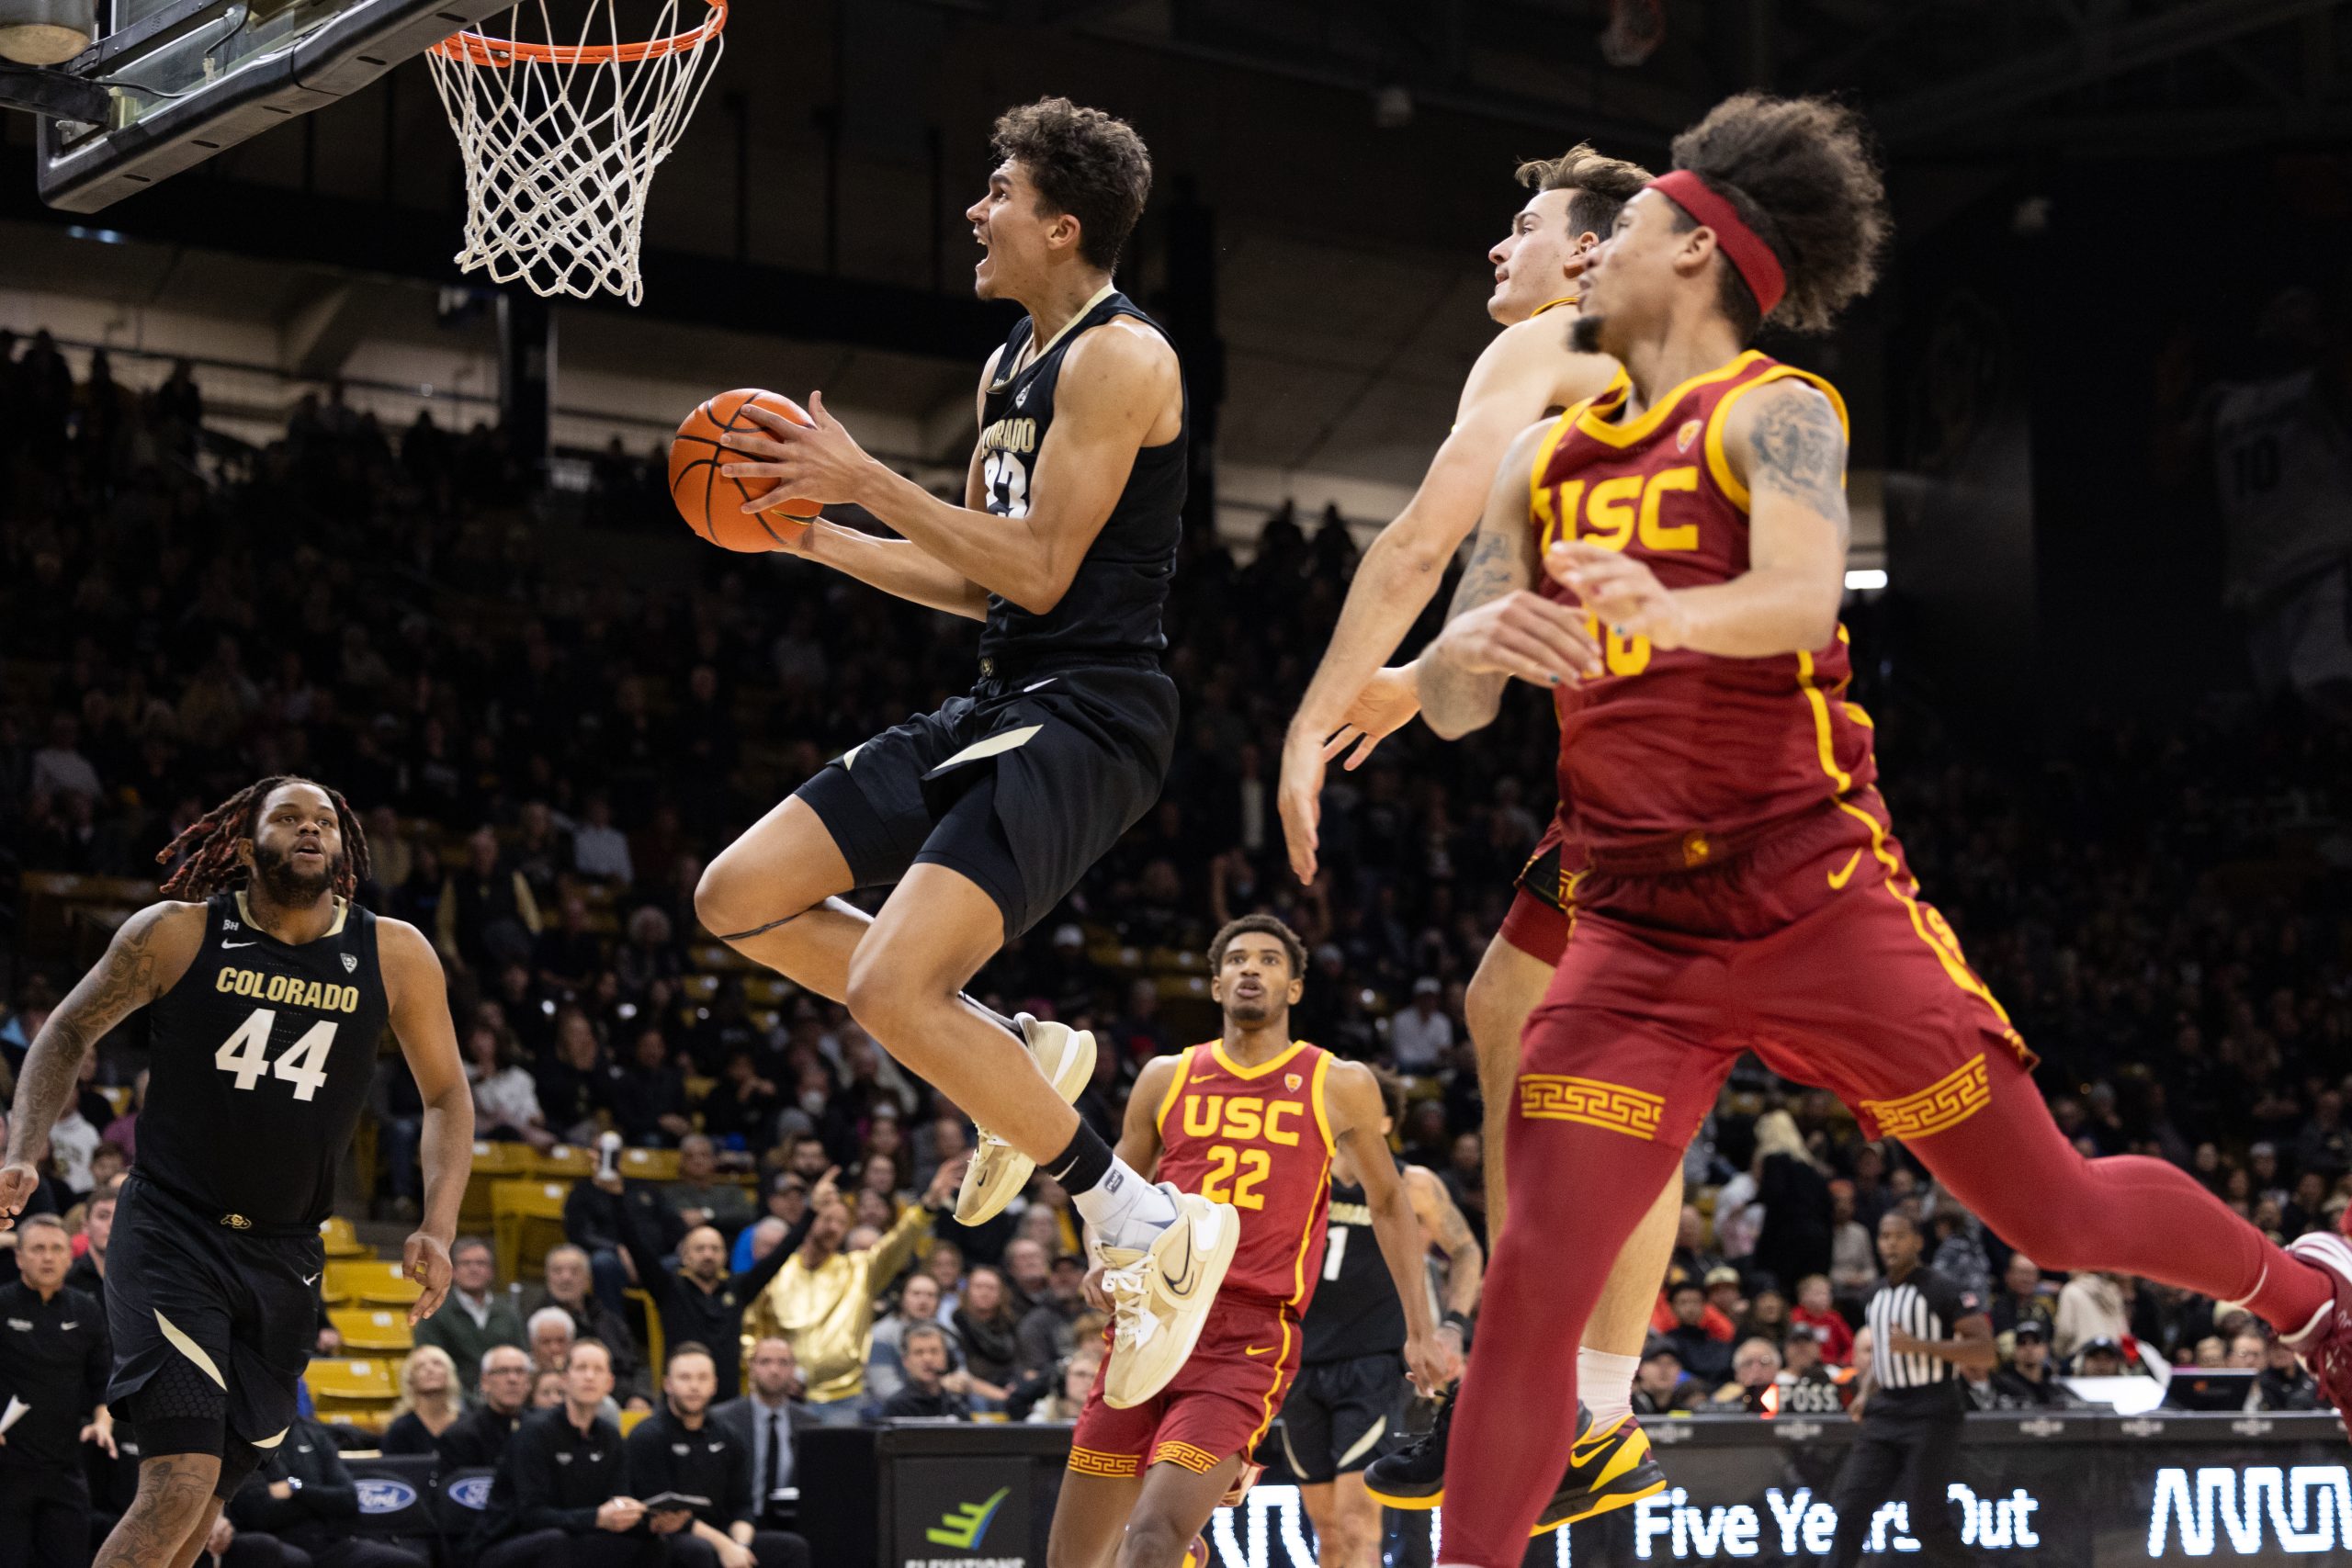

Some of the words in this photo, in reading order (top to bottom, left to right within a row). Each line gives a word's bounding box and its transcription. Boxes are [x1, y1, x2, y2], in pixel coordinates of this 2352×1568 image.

[215, 966, 360, 1013] COLORADO
[214, 1008, 339, 1102] 44
[1183, 1094, 1305, 1147] USC
[1201, 1145, 1272, 1211] 22
[1634, 1486, 1760, 1560] Five
[1766, 1485, 1922, 1555] Yer
